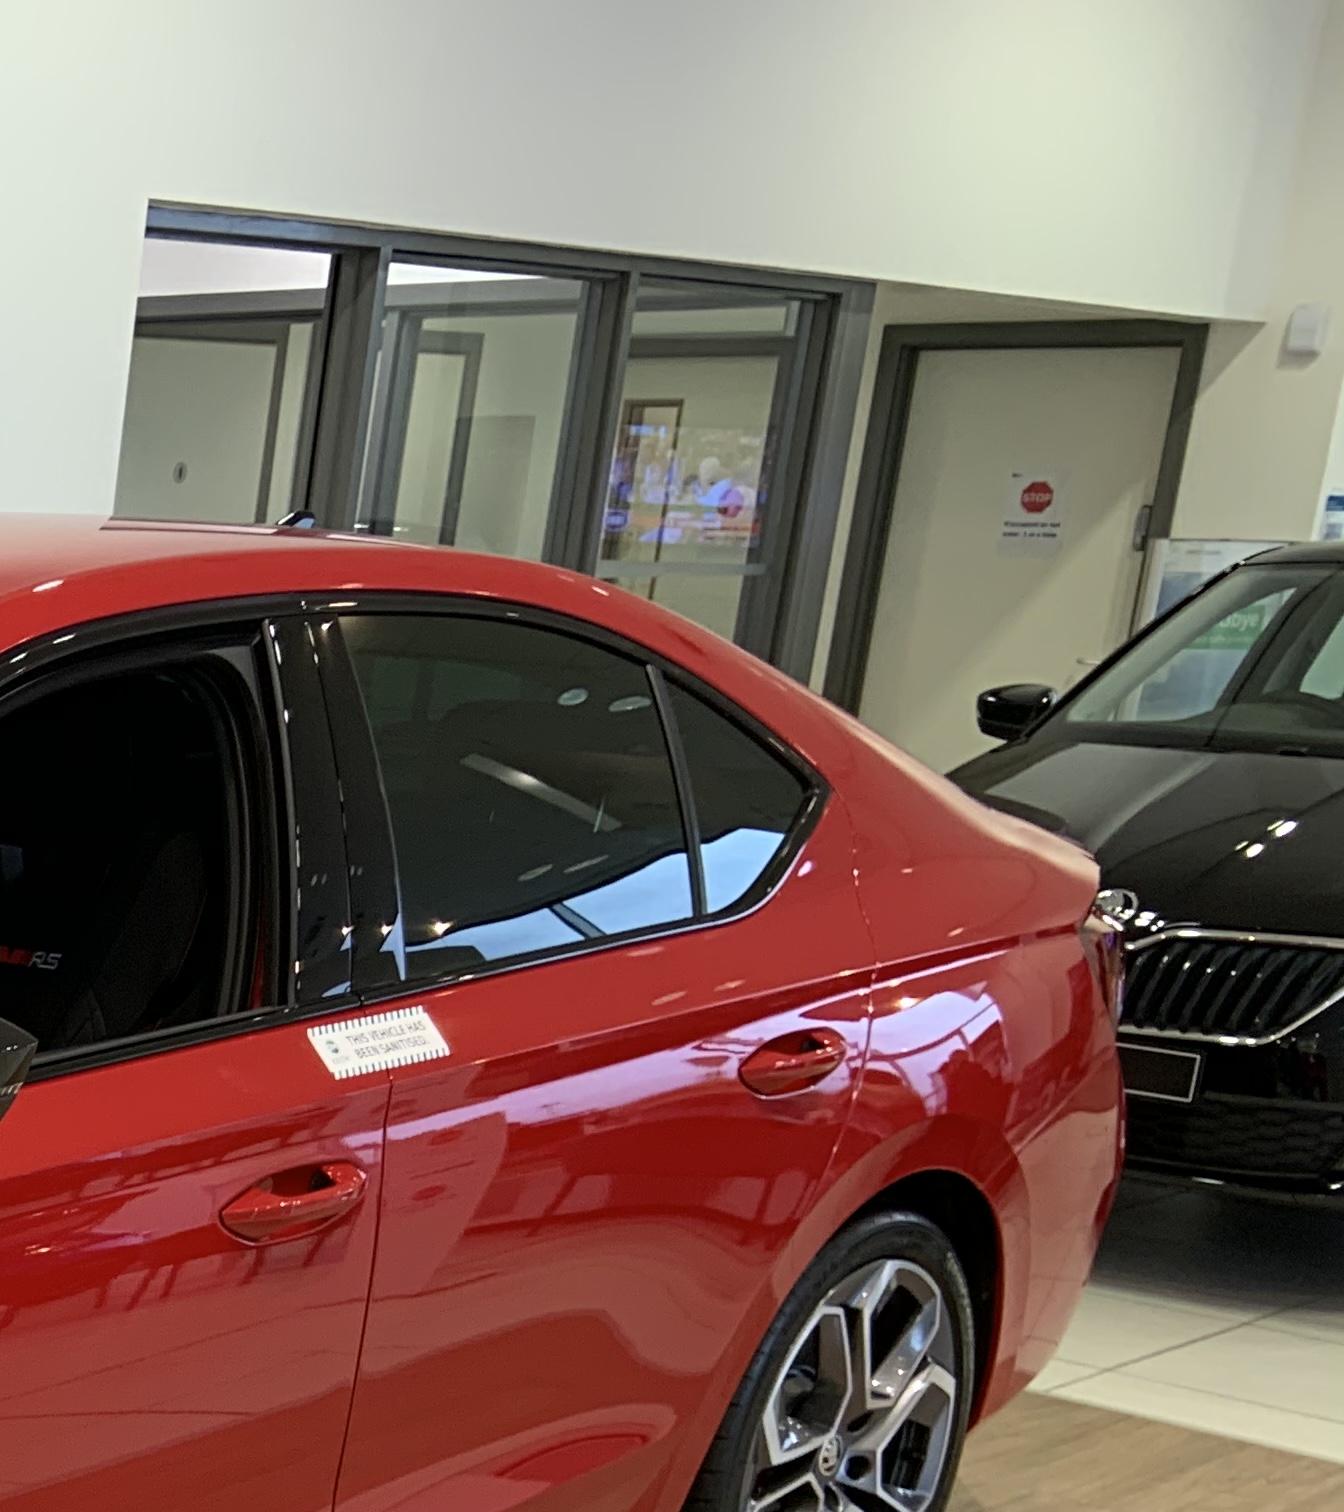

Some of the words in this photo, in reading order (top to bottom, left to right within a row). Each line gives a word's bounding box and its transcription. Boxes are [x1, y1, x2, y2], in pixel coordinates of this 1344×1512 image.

[1022, 492, 1052, 503] STOP
[345, 1031, 370, 1046] THIS
[368, 1025, 407, 1041] VEHICLE
[406, 1020, 427, 1034] HAS
[354, 1045, 380, 1059] BEEN
